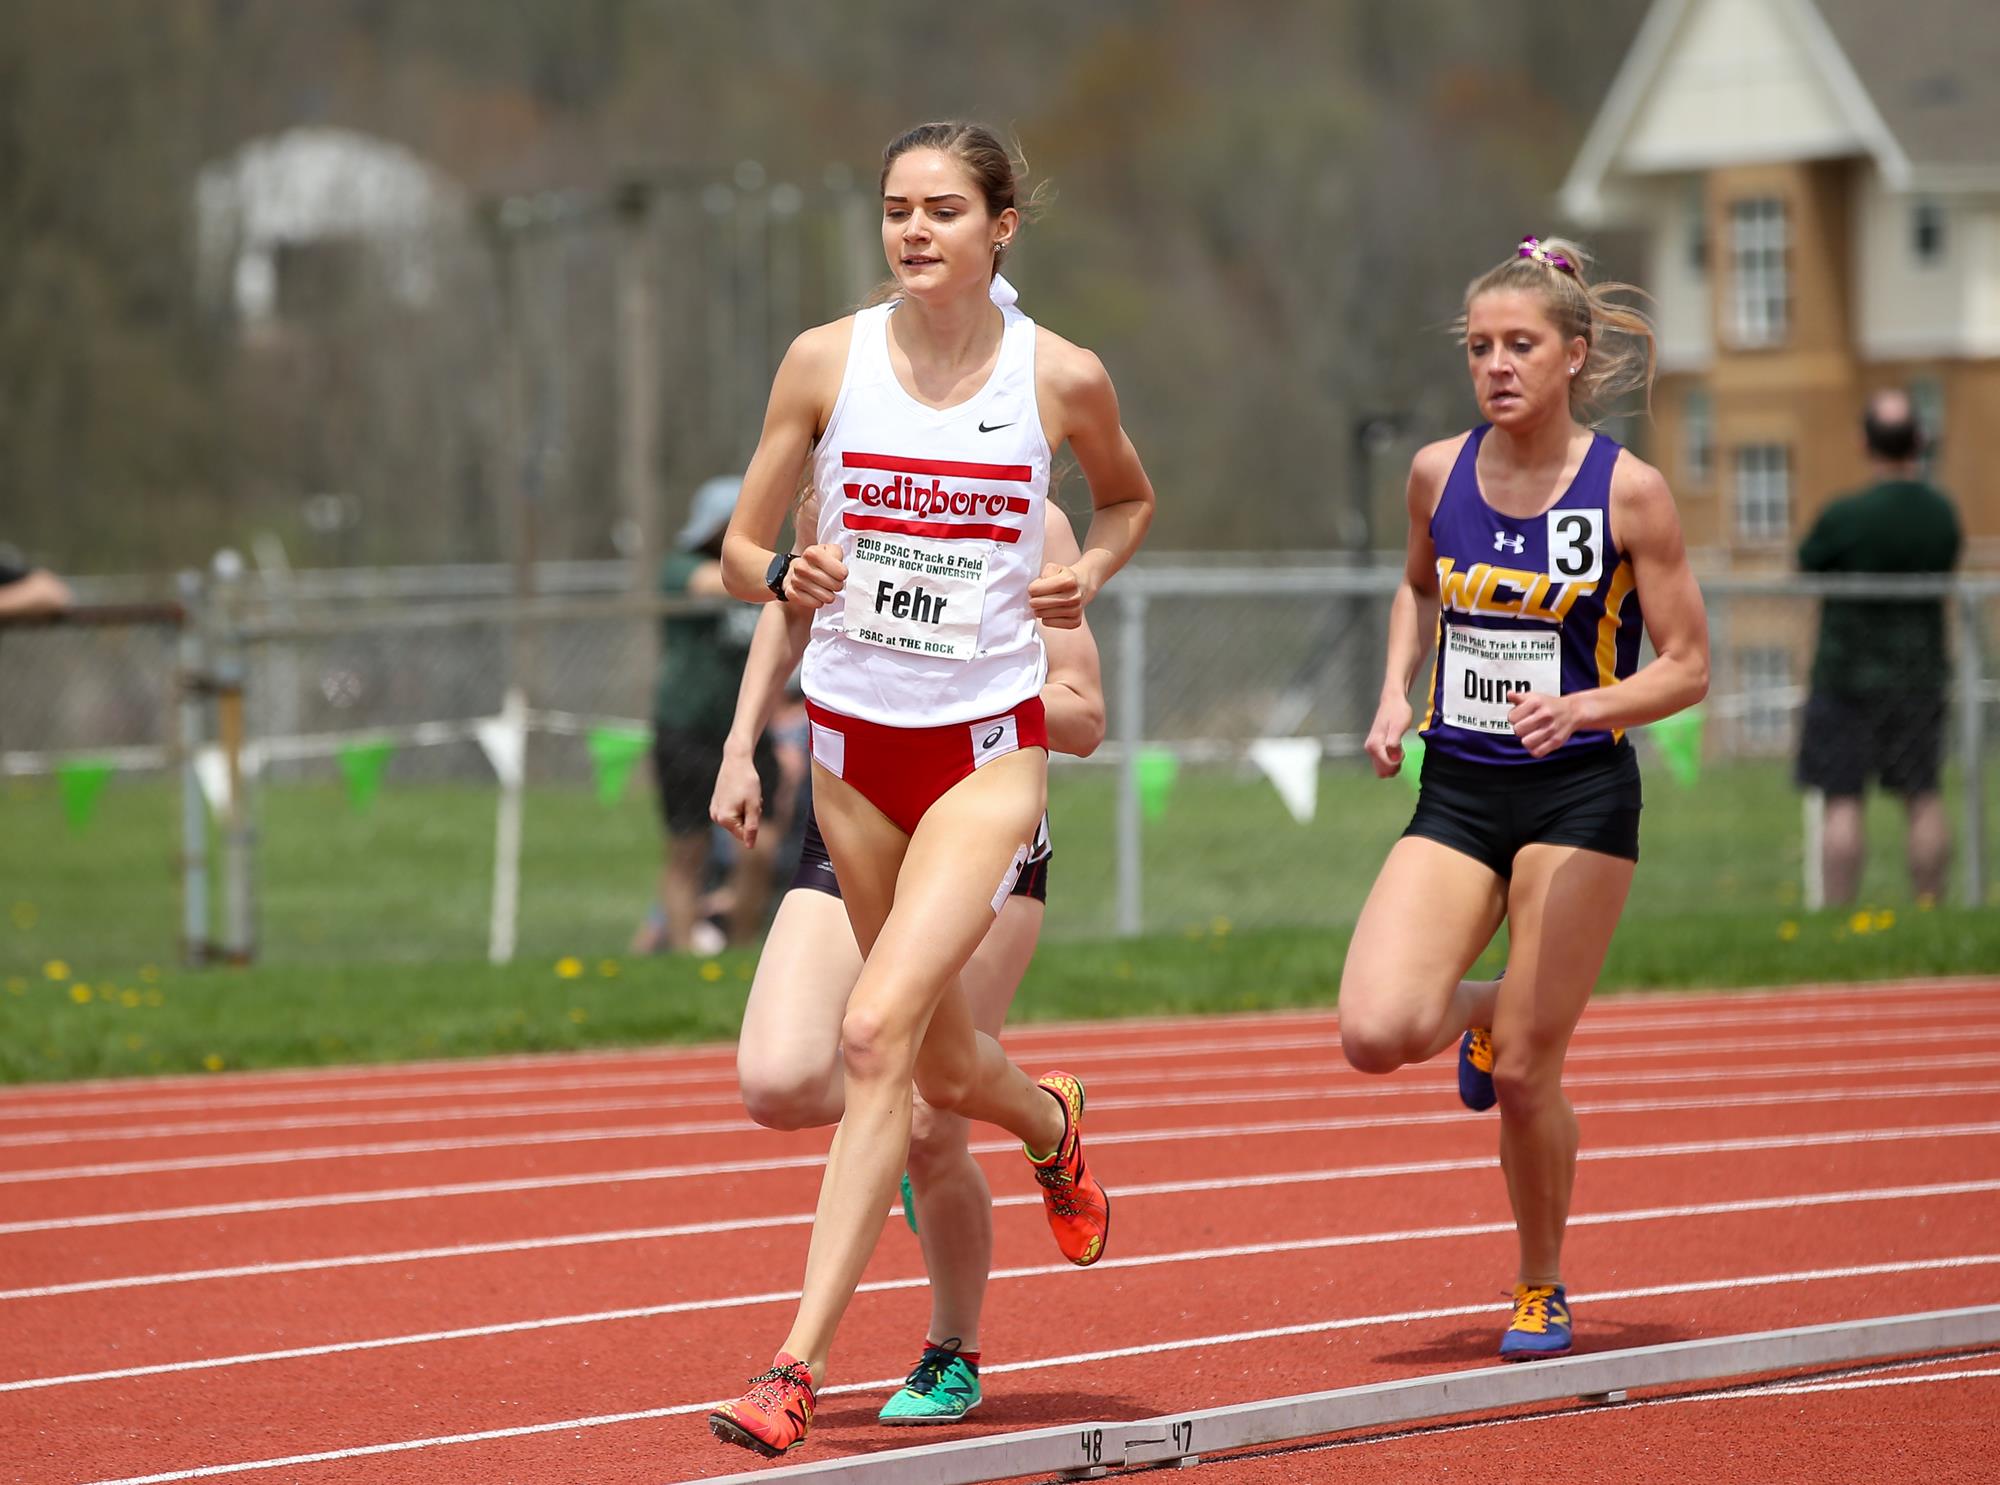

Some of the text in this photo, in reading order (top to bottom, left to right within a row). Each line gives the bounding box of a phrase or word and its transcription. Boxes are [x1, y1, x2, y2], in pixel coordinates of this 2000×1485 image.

[861, 475, 1006, 519] edinboro
[857, 538, 983, 570] 2018 PSAC Track & Field
[1556, 515, 1594, 576] 3
[856, 550, 981, 580] SLIPPERY ROCK UNIVERSITY
[875, 580, 948, 624] Fehr
[1437, 557, 1599, 623] WCU
[859, 628, 954, 654] PSAC at THE ROCK
[1489, 640, 1517, 649] Track
[1531, 640, 1555, 650] Field
[1503, 652, 1555, 660] UNIVERSITY
[1490, 720, 1510, 729] THE
[1081, 1428, 1102, 1462] 48
[1172, 1420, 1192, 1453] 47
